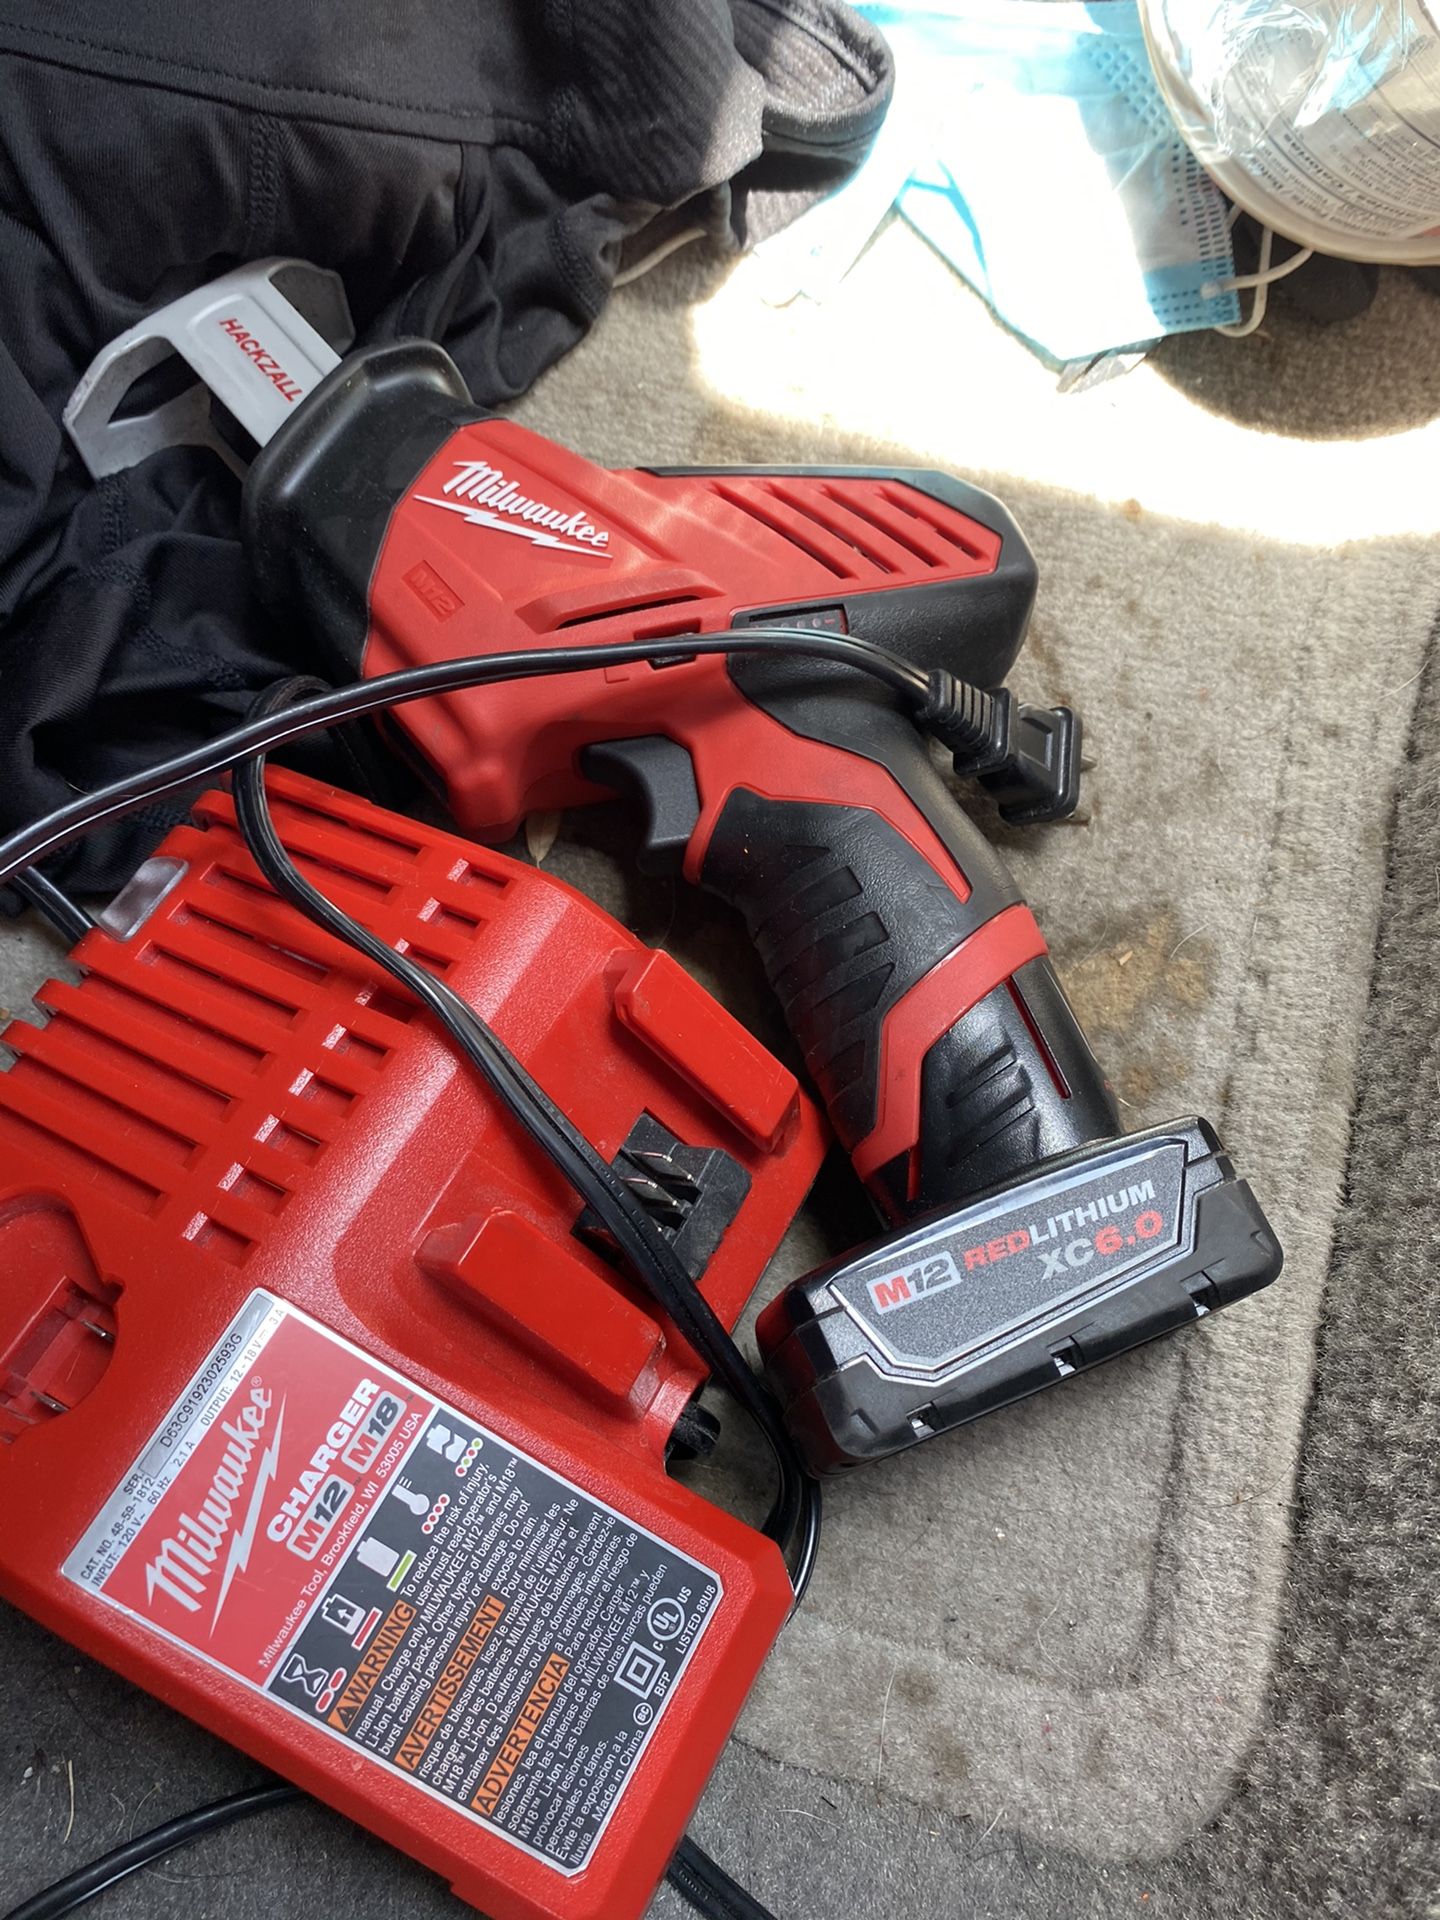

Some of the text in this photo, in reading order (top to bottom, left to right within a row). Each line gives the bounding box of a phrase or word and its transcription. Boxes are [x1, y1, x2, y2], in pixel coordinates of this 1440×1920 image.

[219, 318, 304, 403] HACKZALL
[453, 460, 611, 548] Milwaukee
[409, 571, 457, 614] M12
[873, 1179, 1156, 1308] M12 REDLITHIUM
[1037, 1210, 1163, 1280] XC6.0
[90, 1550, 120, 1587] INPUT:
[117, 1526, 136, 1547] 120
[146, 1490, 161, 1505] 60
[156, 1474, 171, 1490] Hz
[172, 1450, 188, 1466] 2.1
[184, 1439, 195, 1449] A
[199, 1384, 232, 1426] OUTPUT:
[229, 1368, 243, 1383] 12
[243, 1348, 257, 1362] 18
[123, 1331, 243, 1495] SER. D63C9192302593G
[262, 1375, 380, 1545] CHARGER
[291, 1394, 402, 1555] M12 M18
[79, 1476, 155, 1580] CAT. NO. 48-59-1812
[145, 1387, 272, 1613] Milwaukee
[257, 1409, 422, 1669] Milwaukee Tool, Brookfield, WI 53005 USA
[400, 1459, 490, 1599] To reduce the risk of injury,
[415, 1579, 436, 1607] user
[428, 1550, 452, 1580] must
[445, 1525, 466, 1552] read
[490, 1511, 539, 1592] expose to rain.
[500, 1500, 560, 1598] Pour minimiser les
[342, 1601, 415, 1708] WARNING
[352, 1690, 387, 1740] manual.
[380, 1646, 415, 1693] Charge
[405, 1621, 429, 1650] only
[419, 1549, 468, 1623] MILWAUKEE
[482, 1491, 501, 1515] and
[365, 1485, 524, 1748] Li-Ion battery packs. Other types of batteries may
[378, 1498, 530, 1756] burst causing personal injury or damage. Do not
[416, 1496, 578, 1780] risque de blessures, lisez le manel de l'utilisateur. Ne
[429, 1738, 464, 1787] charger
[457, 1715, 477, 1741] que
[468, 1694, 486, 1715] les
[478, 1645, 513, 1696] batteries
[505, 1574, 552, 1647] MILWAUKEE
[564, 1524, 578, 1539] et
[455, 1514, 615, 1801] entrainer des blessures ou des dommages. Gardez-le
[464, 1713, 492, 1752] Li-Ion.
[485, 1664, 518, 1714] D'autres
[513, 1617, 547, 1667] marques
[538, 1599, 553, 1617] de
[546, 1553, 579, 1601] batteries
[572, 1510, 604, 1556] puevent
[554, 1641, 564, 1652] a
[581, 1530, 625, 1597] intemperies.
[564, 1530, 638, 1658] Para reducir el riesgo de
[652, 1604, 679, 1633] UL
[676, 1585, 692, 1604] US
[675, 1583, 716, 1654] LISTED 89U8
[396, 1596, 503, 1768] AVERTISSEMENT
[473, 1654, 568, 1813] ADVERTENCIA
[492, 1582, 628, 1825] lesiones, lea el manual del operador. Cargar
[505, 1767, 545, 1831] solamente
[537, 1748, 555, 1769] las
[547, 1701, 579, 1749] baterias
[572, 1684, 588, 1703] de
[581, 1613, 625, 1686] MILWAUKEE
[639, 1569, 650, 1579] y
[538, 1757, 566, 1797] Li-Ion.
[559, 1734, 578, 1759] Las
[570, 1688, 602, 1736] baterias
[594, 1671, 610, 1690] de
[603, 1642, 625, 1673] otras
[620, 1603, 646, 1644] marcas
[639, 1561, 669, 1605] pueden
[653, 1670, 672, 1697] BFP
[532, 1742, 589, 1847] provocar lesiones
[542, 1735, 608, 1854] personales o danos.
[555, 1728, 628, 1860] Evite la exposicion a la
[569, 1727, 644, 1864] lluvia. Made in China
